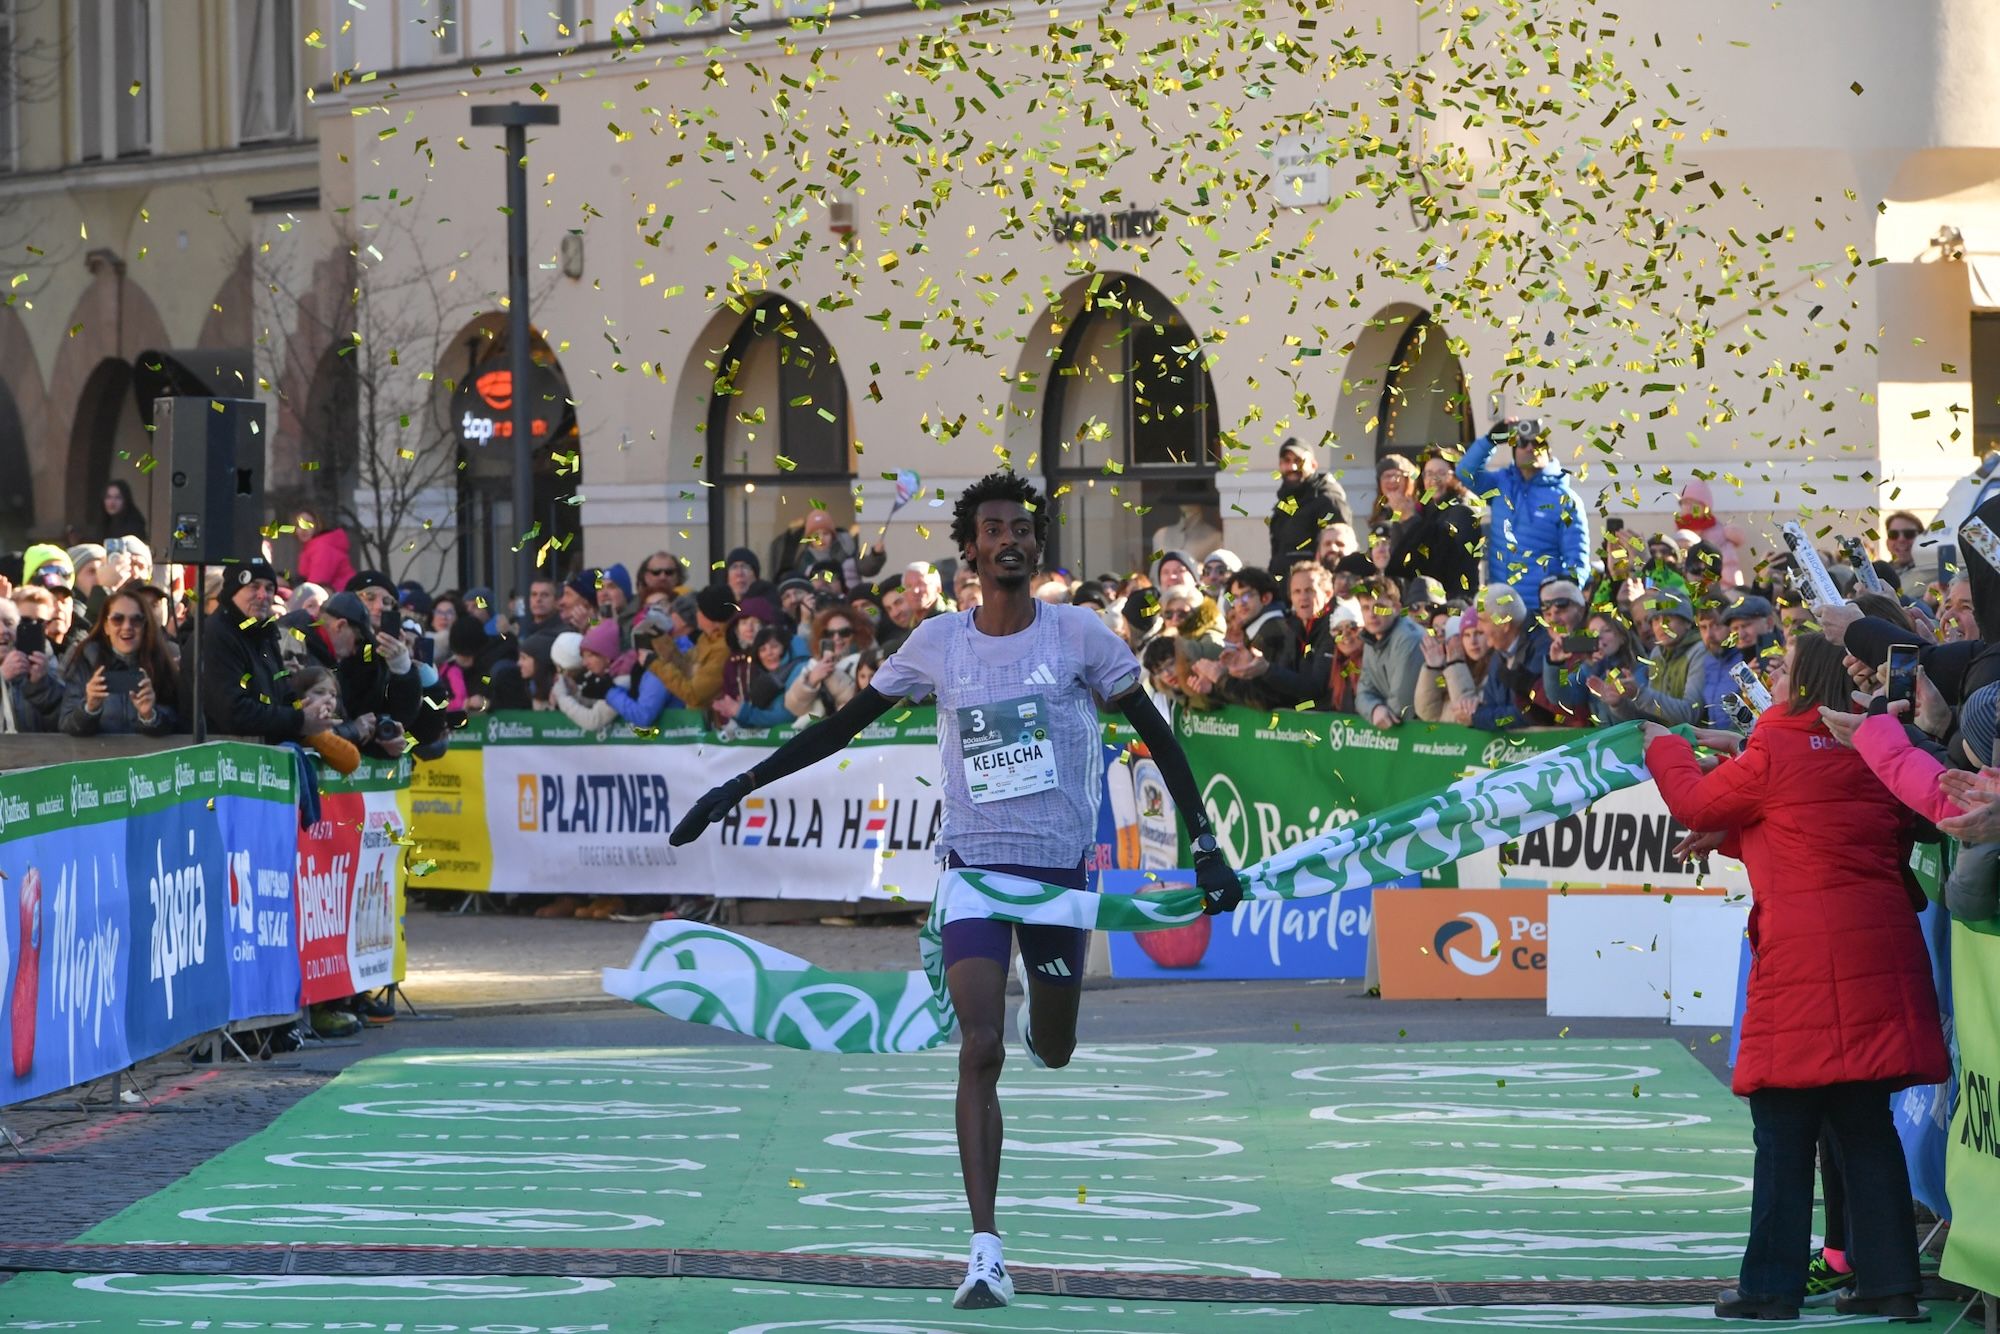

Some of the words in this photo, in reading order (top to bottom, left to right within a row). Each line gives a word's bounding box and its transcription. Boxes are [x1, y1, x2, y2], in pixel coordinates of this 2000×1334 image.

[970, 709, 986, 732] 3
[1193, 715, 1239, 737] Raiffeisen
[1345, 726, 1399, 751] Raiffeisen
[973, 744, 1043, 772] KEJELCHA
[541, 774, 670, 833] PLATTNER
[150, 829, 207, 1020] alperia
